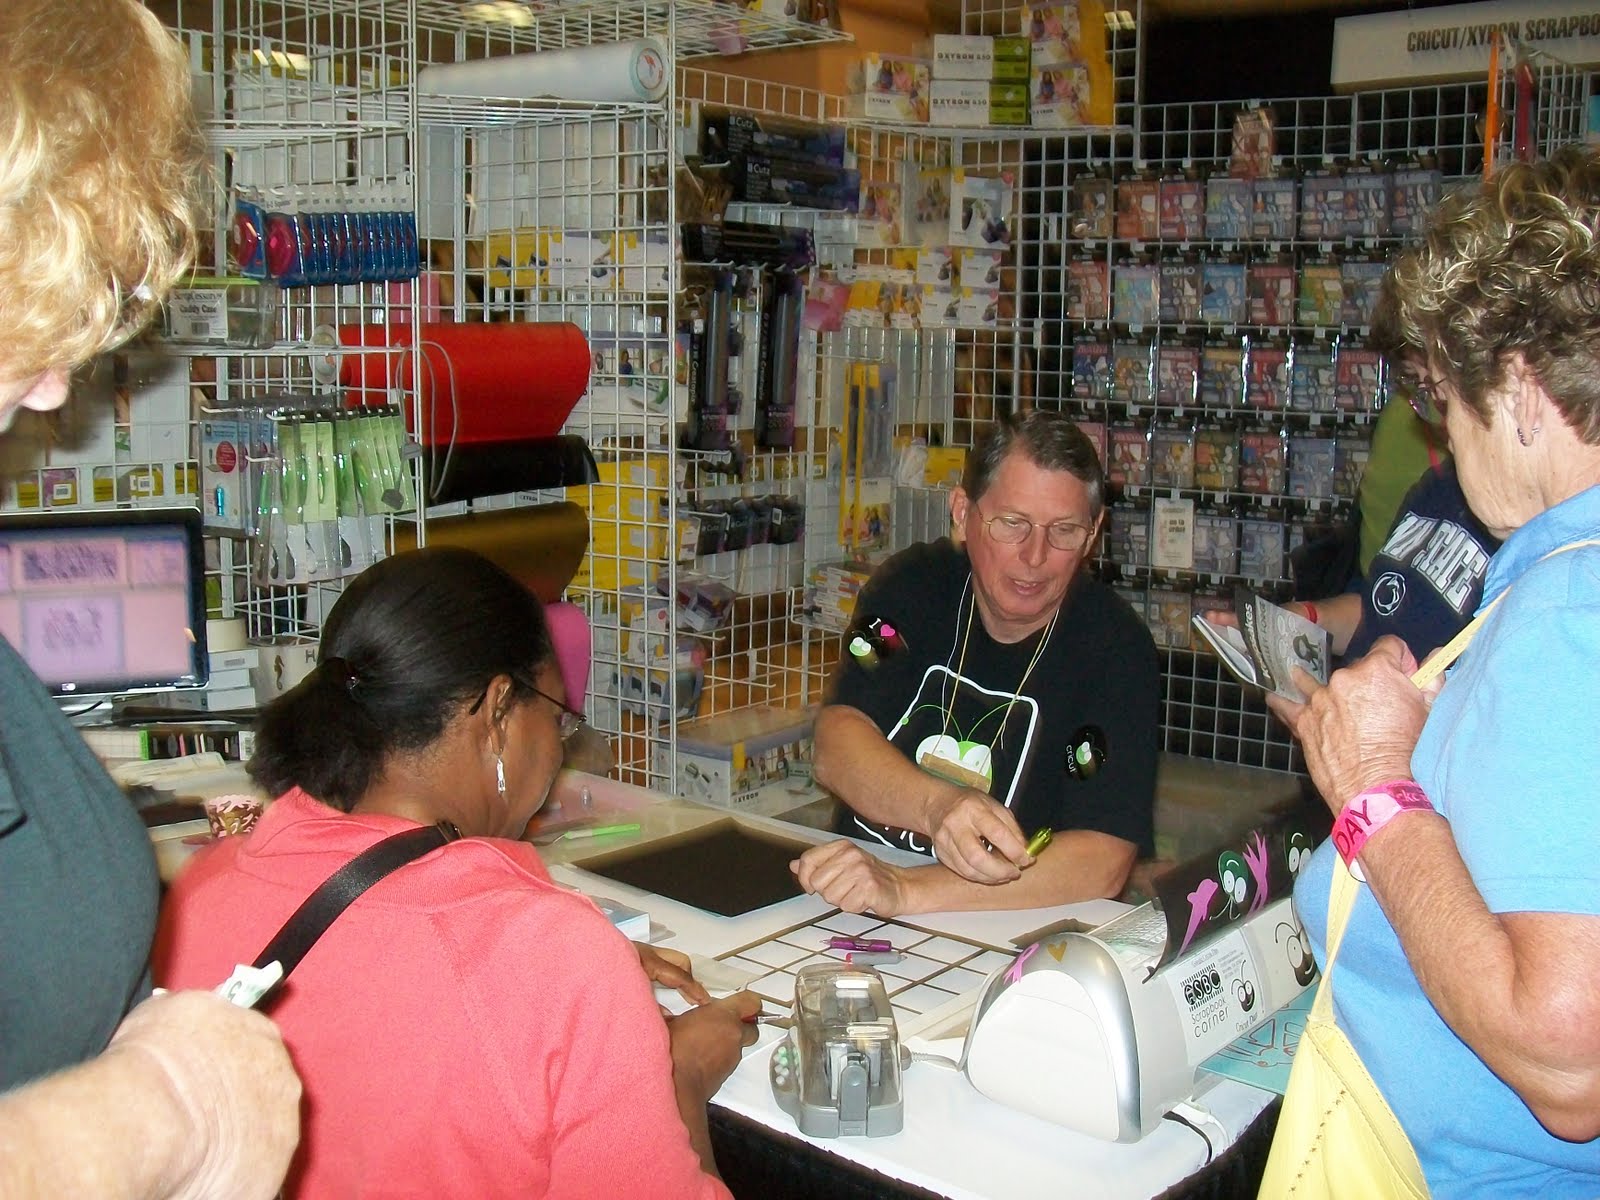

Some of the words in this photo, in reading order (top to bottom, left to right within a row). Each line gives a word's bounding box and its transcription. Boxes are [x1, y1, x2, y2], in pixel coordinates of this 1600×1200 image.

[1162, 267, 1195, 276] IDAHO
[1411, 519, 1491, 614] STATE
[1065, 744, 1077, 773] cricut
[1191, 996, 1227, 1025] Scrapbook
[1194, 1006, 1229, 1038] corner
